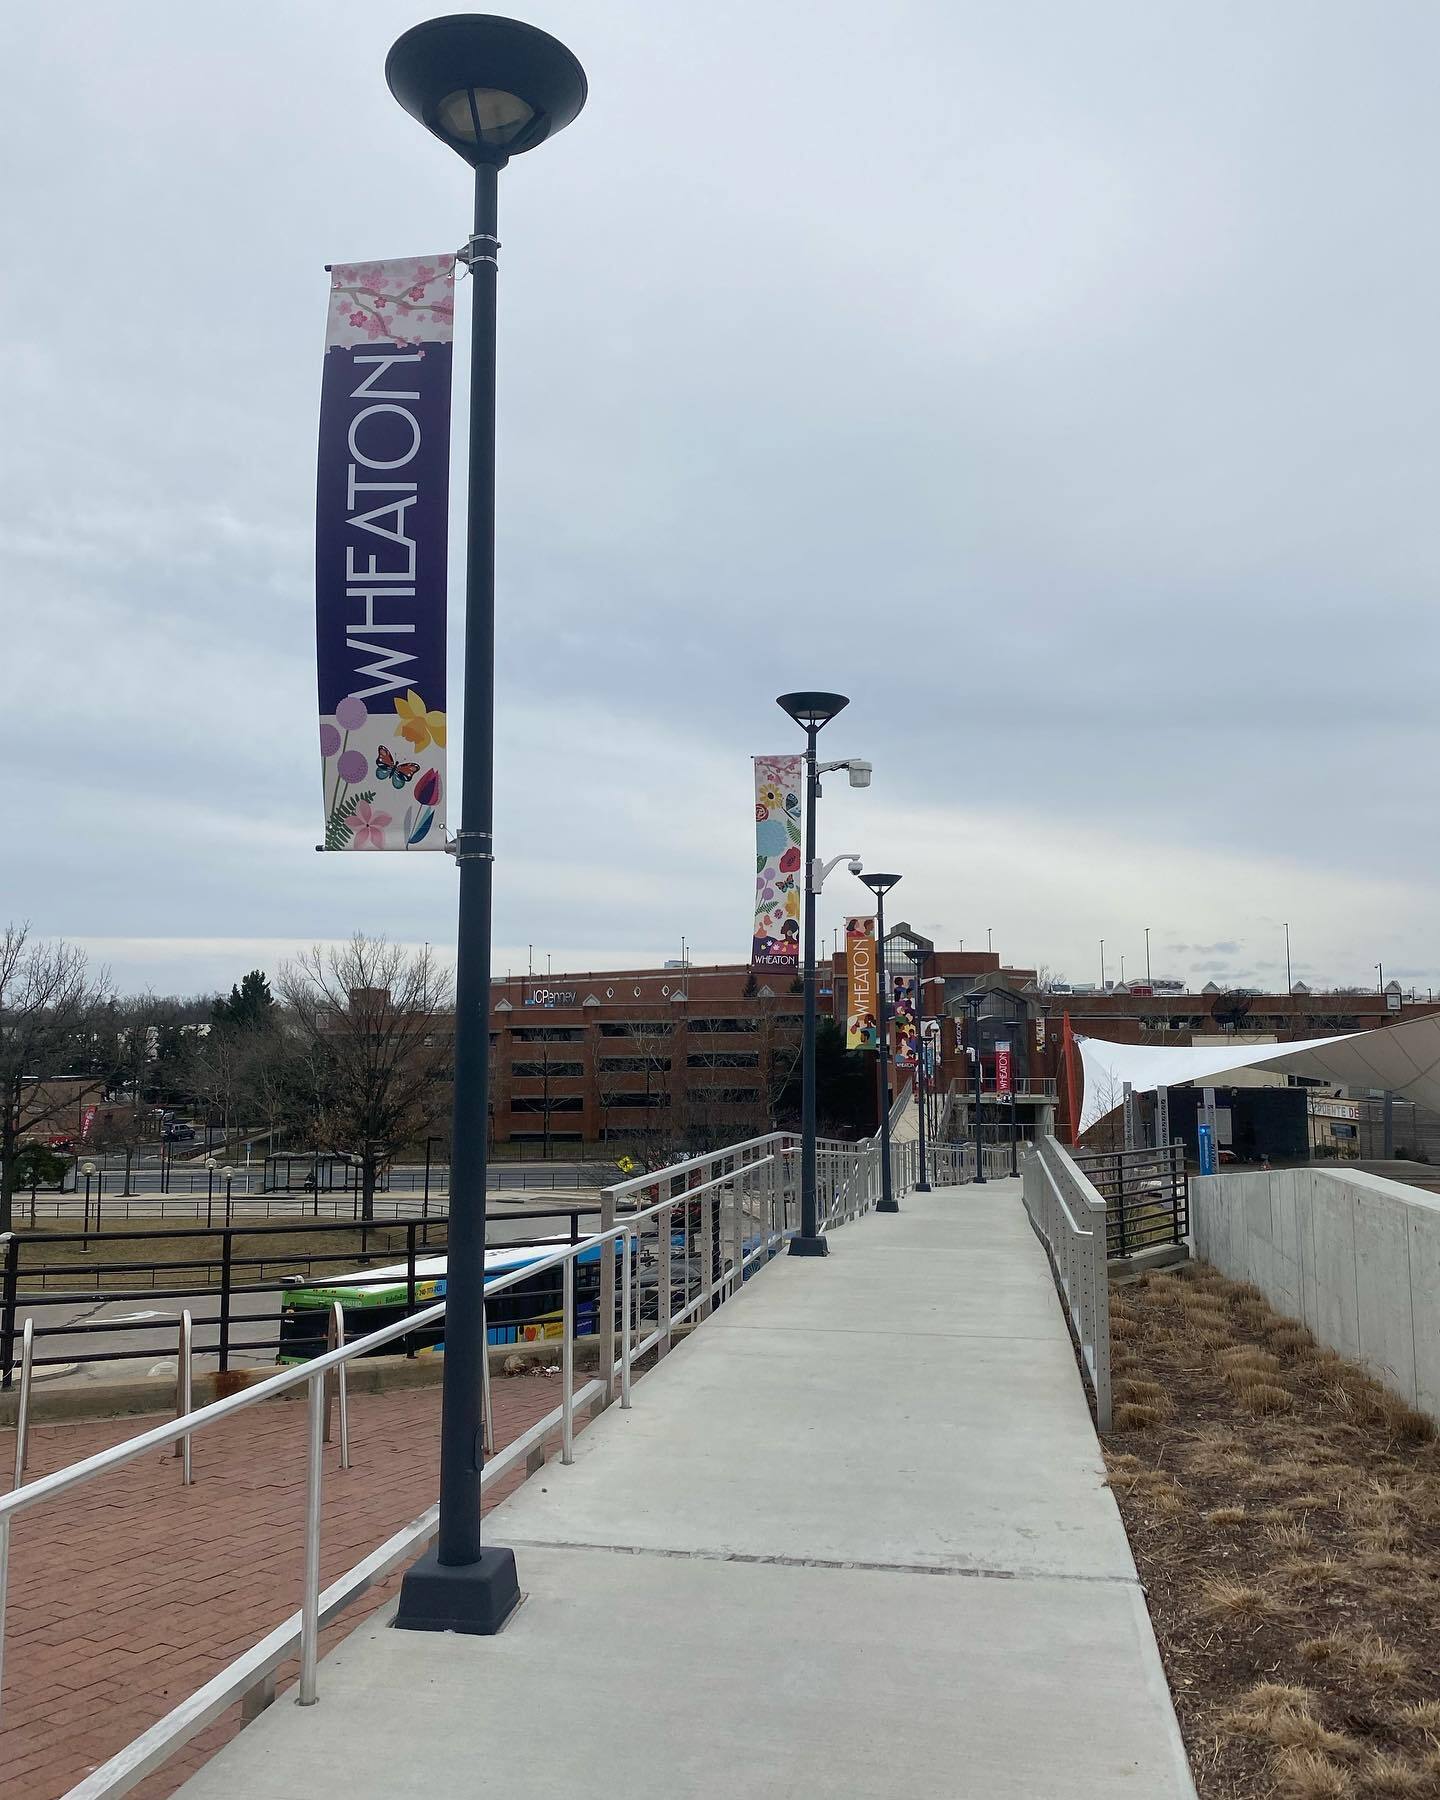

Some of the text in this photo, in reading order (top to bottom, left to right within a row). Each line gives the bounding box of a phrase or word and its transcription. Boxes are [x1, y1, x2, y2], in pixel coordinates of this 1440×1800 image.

[345, 353, 422, 700] WHEATON
[755, 955, 795, 965] WHEATON
[853, 939, 870, 1016] WHEATON
[999, 1052, 1009, 1090] WHEATON
